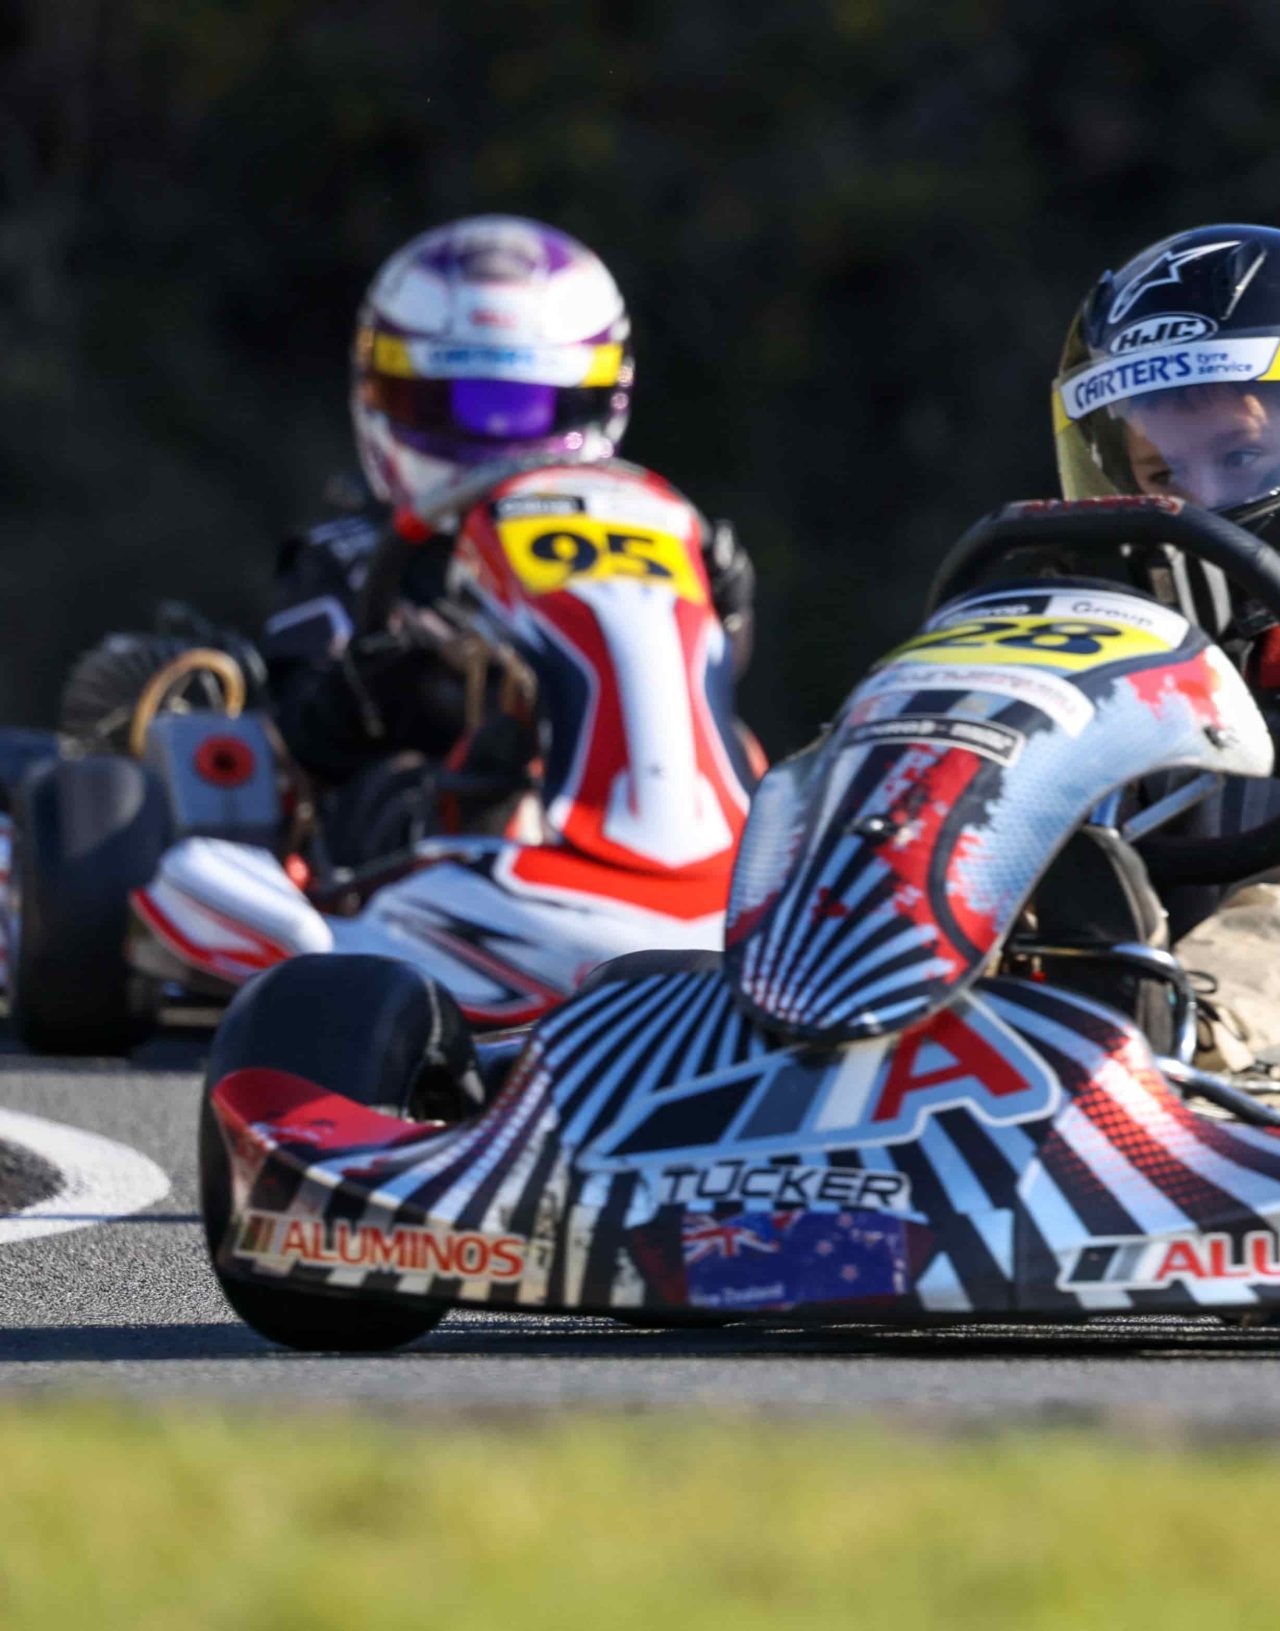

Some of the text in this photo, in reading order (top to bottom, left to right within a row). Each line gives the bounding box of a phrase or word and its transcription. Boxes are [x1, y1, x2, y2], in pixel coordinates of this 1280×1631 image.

[1117, 320, 1200, 352] HJC
[1195, 352, 1229, 364] tyre
[1197, 362, 1253, 375] service
[1074, 352, 1192, 410] CARTER'S
[530, 530, 674, 579] 95
[1071, 601, 1153, 626] Group
[895, 621, 1123, 655] 28
[661, 1159, 904, 1206] TUCKER
[279, 1221, 524, 1278] ALUMINOS
